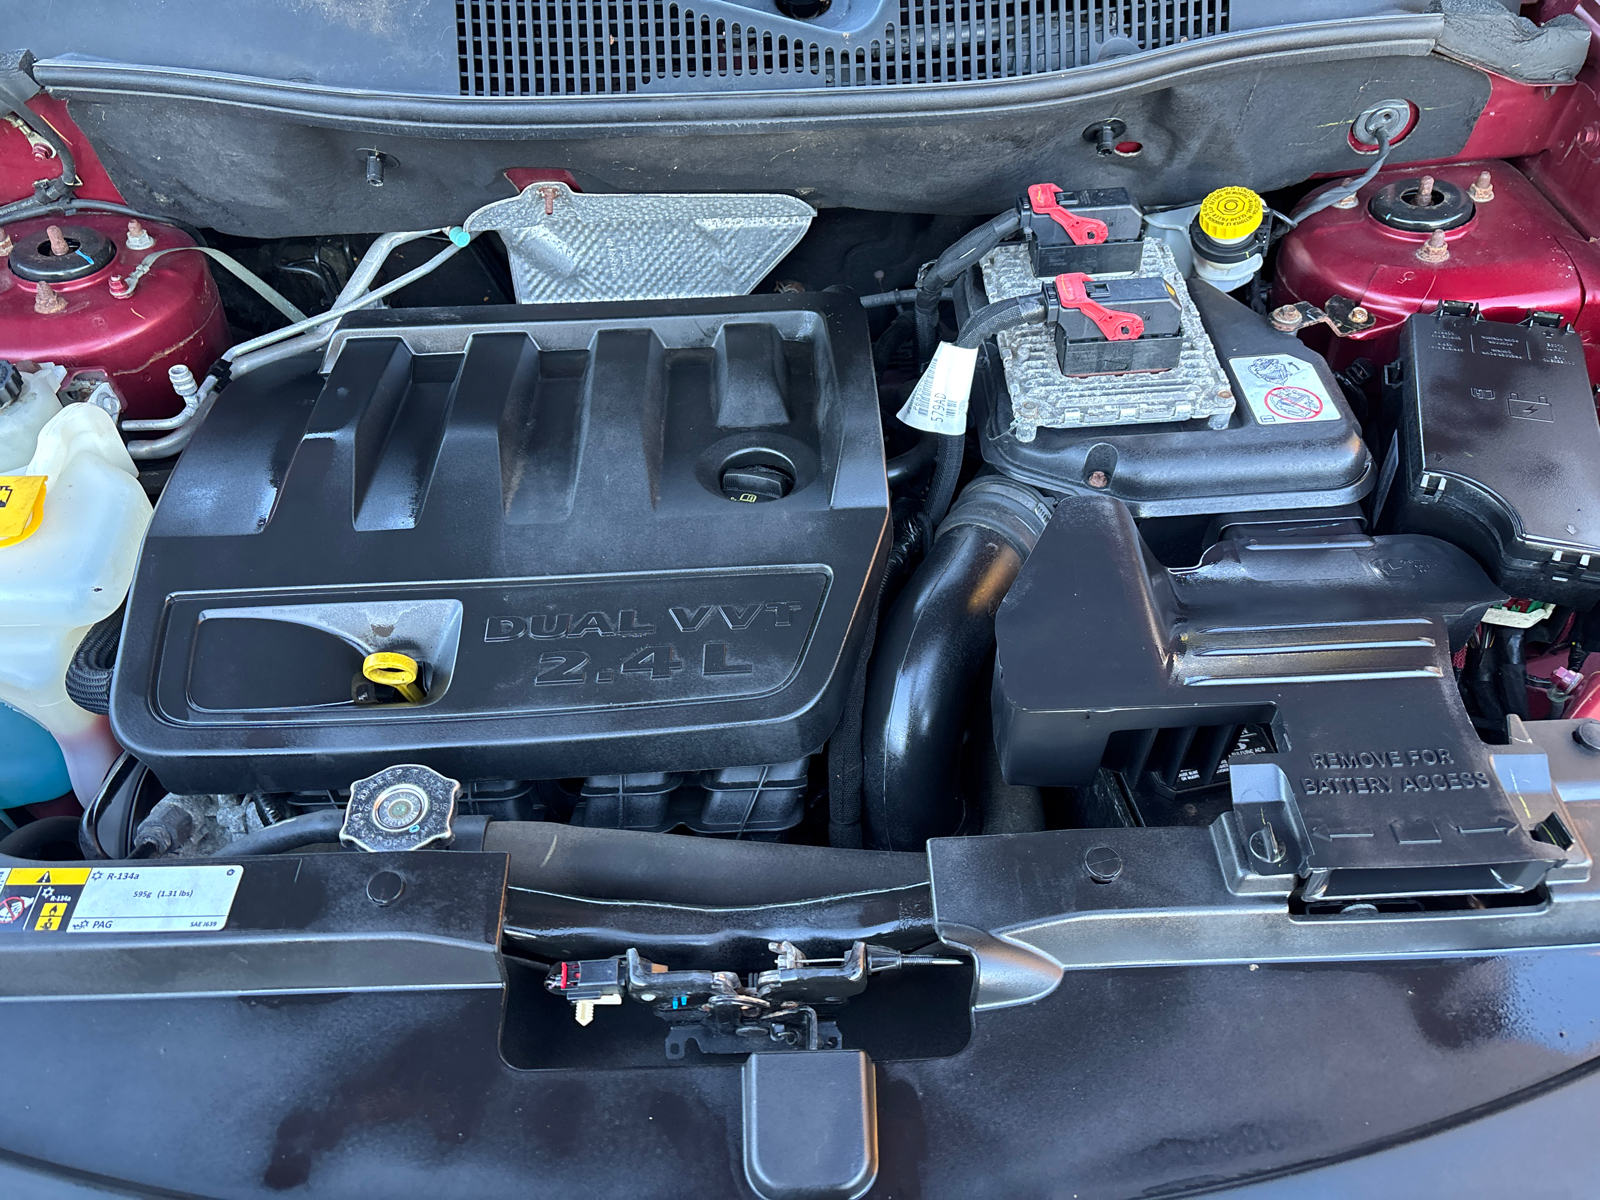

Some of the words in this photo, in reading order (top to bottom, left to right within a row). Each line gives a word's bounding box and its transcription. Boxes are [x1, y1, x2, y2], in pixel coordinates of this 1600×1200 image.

[930, 392, 947, 423] 579AD
[484, 610, 656, 642] DUAL
[668, 601, 802, 633] VVT
[1311, 750, 1403, 769] REMOVE
[1407, 748, 1455, 766] FOR
[1303, 776, 1393, 795] BATTERY
[1403, 772, 1491, 792] ACCESS
[107, 872, 140, 881] R-134a
[50, 894, 72, 902] R-134a
[132, 890, 153, 899] 595g
[157, 889, 178, 899] (1.31
[178, 889, 194, 898] lbs)
[92, 920, 114, 929] PAG
